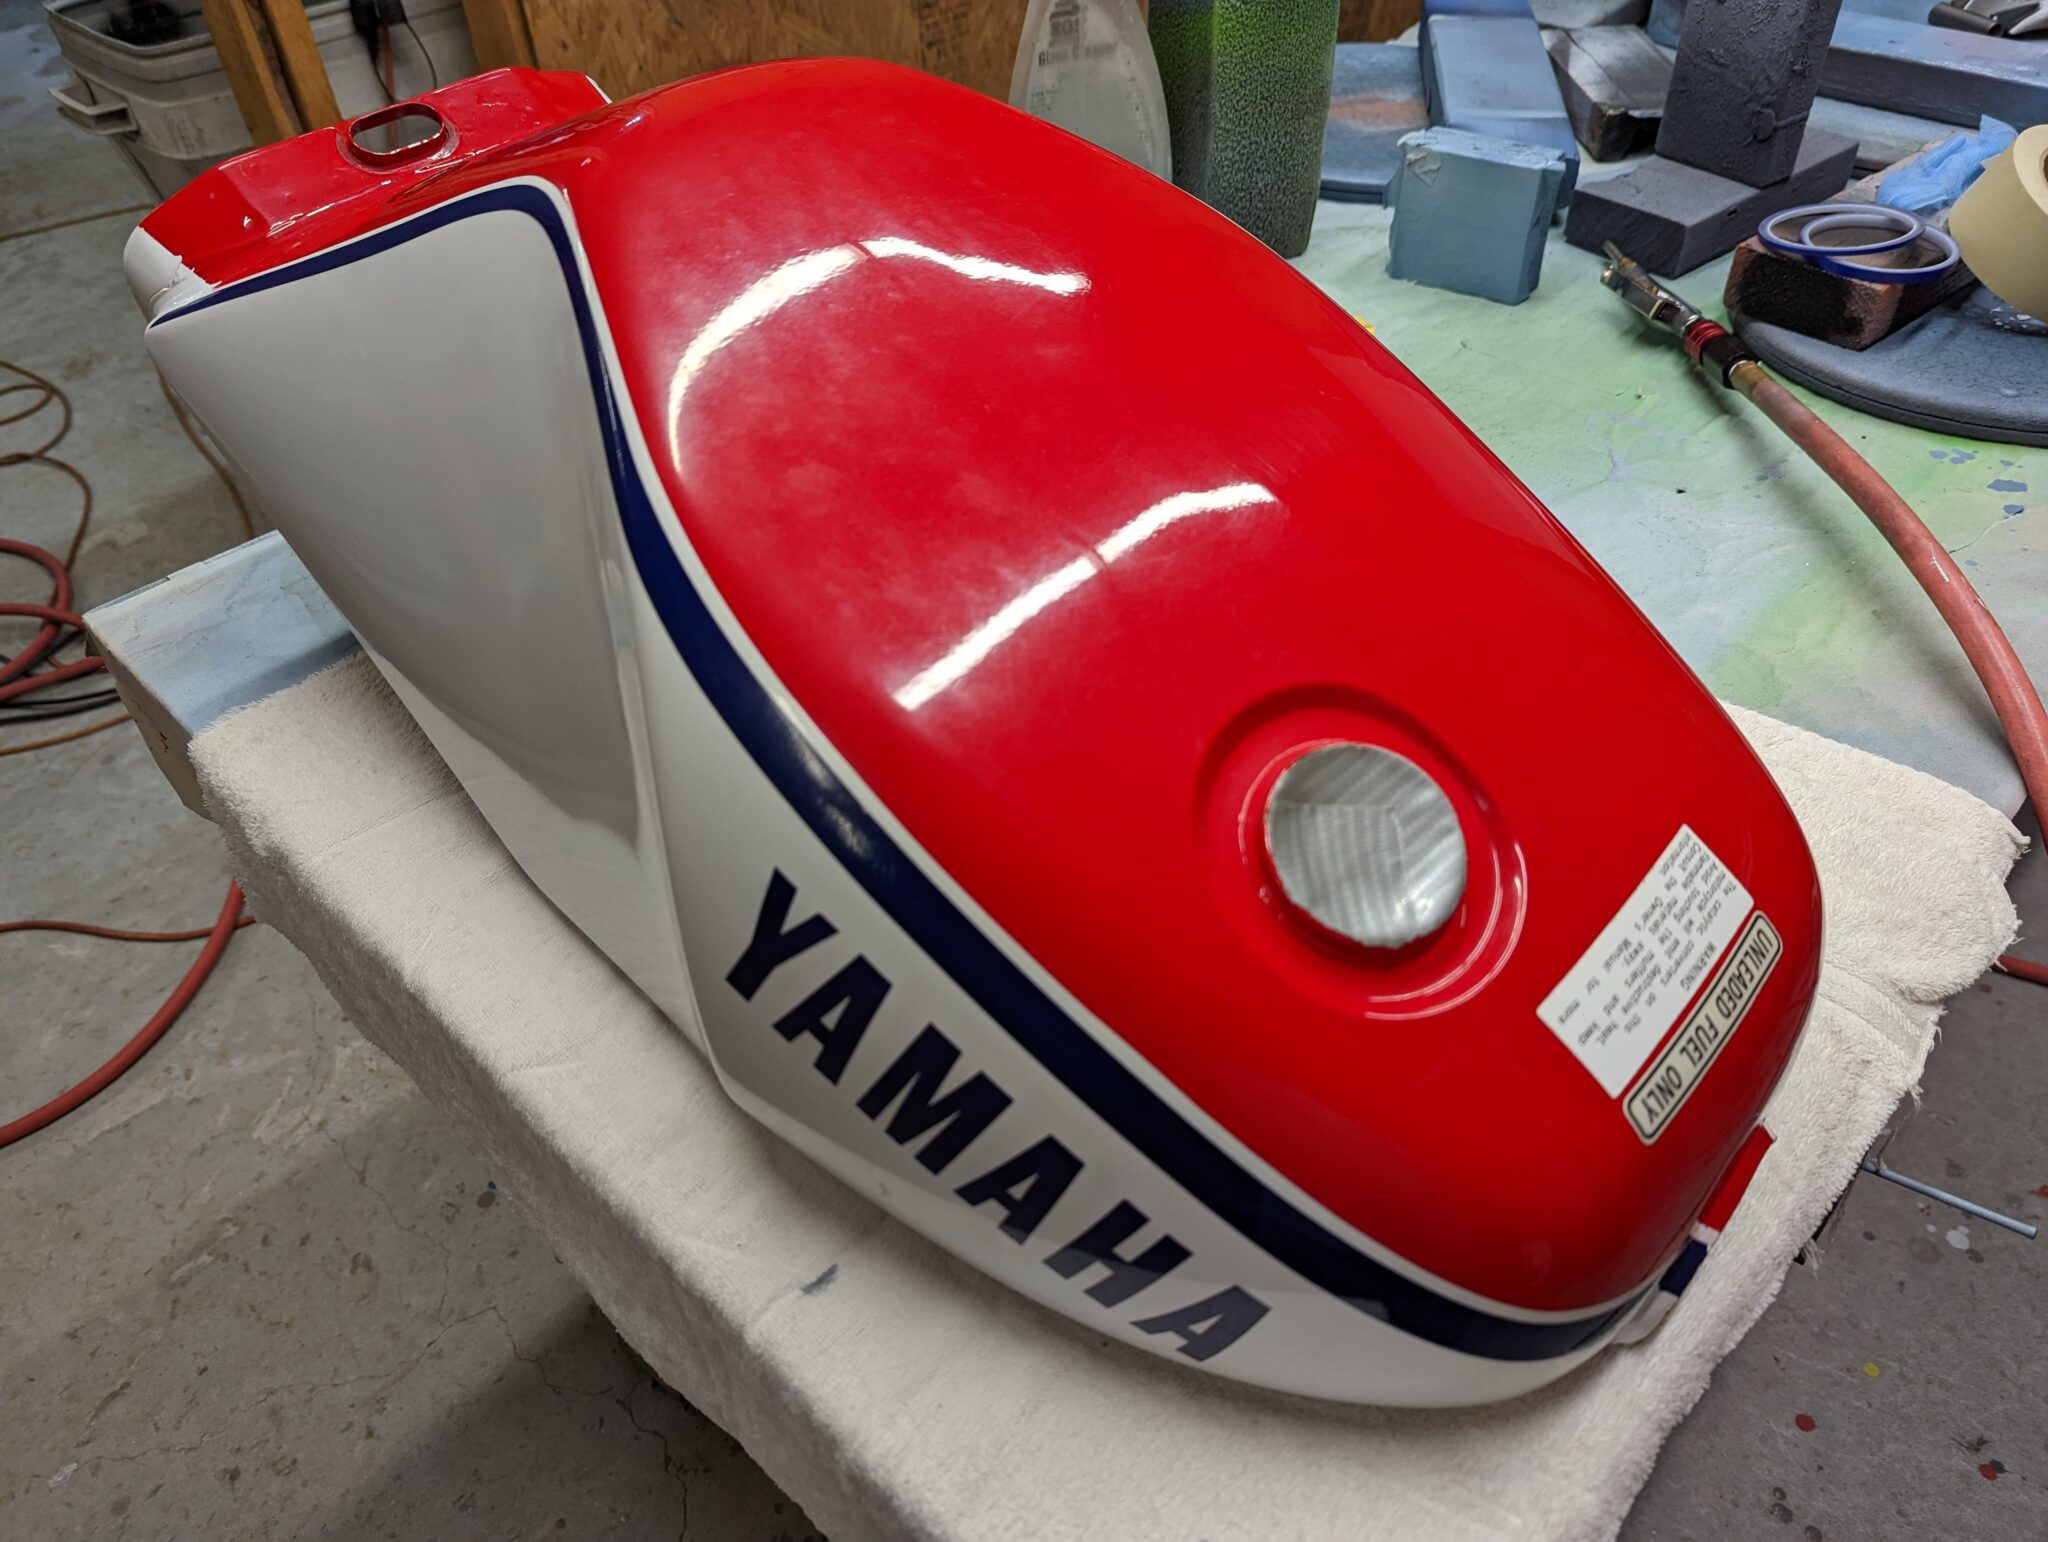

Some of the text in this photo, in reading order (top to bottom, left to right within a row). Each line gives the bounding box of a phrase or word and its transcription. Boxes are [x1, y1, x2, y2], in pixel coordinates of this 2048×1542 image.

[1677, 840, 1703, 874] Consult
[1663, 875, 1678, 893] the
[1695, 869, 1727, 914] motorcycle
[1647, 895, 1679, 937] materials
[1672, 886, 1701, 925] touching
[1657, 926, 1673, 947] the
[1663, 936, 1681, 961] emit
[1602, 935, 1634, 974] Manual
[1659, 939, 1696, 987] converters
[1680, 941, 1718, 992] WARNING
[1585, 975, 1601, 995] for
[1620, 963, 1662, 1016] destructive
[1644, 991, 1657, 1008] on
[1557, 998, 1581, 1026] more
[1602, 993, 1621, 1018] and
[1577, 1020, 1601, 1047] keep
[1623, 1012, 1642, 1034] this
[1641, 928, 1774, 1124] UNLEADED FUEL ONLY
[725, 866, 1272, 1362] YAMAHA
